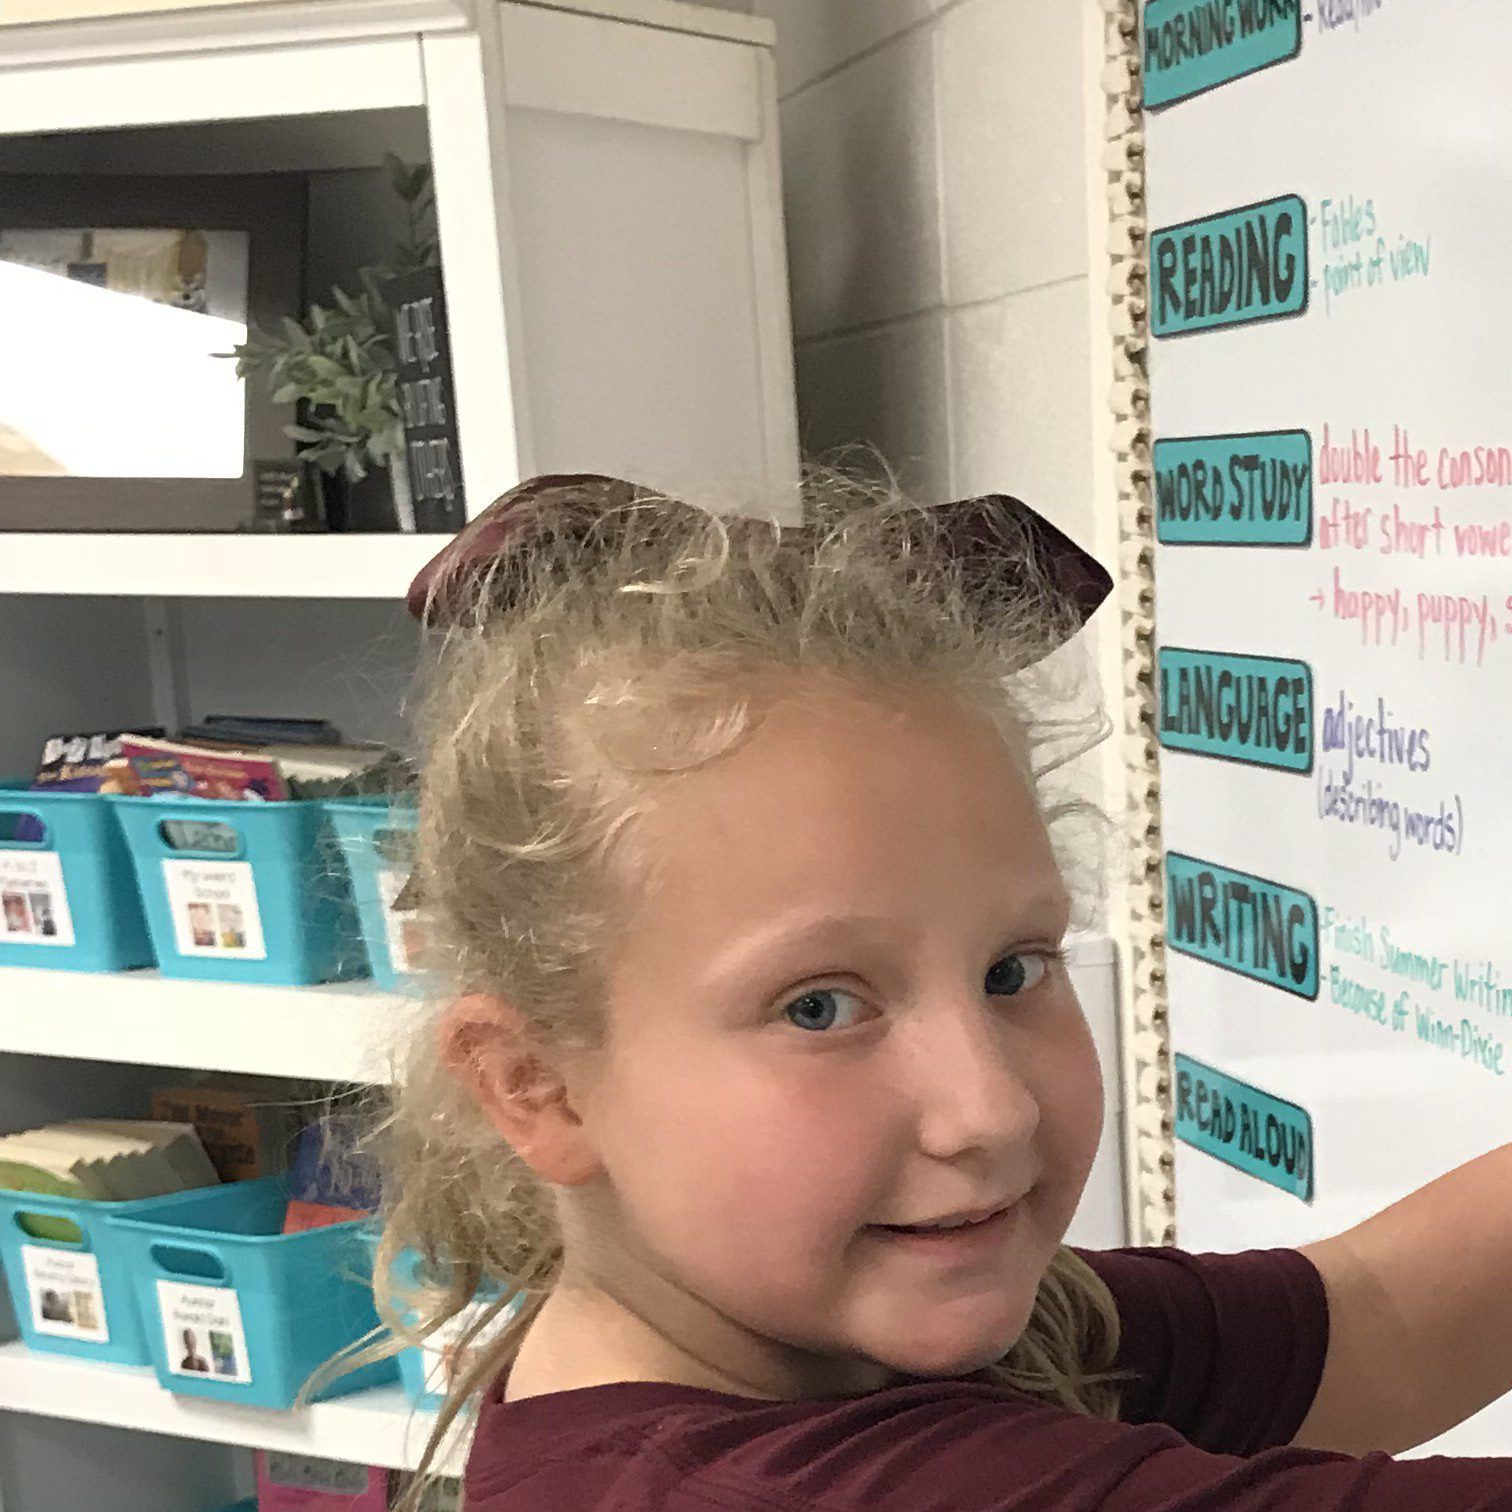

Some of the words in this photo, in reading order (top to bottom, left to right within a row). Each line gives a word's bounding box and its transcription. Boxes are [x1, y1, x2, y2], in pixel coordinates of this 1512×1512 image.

[1157, 212, 1296, 325] READING
[1156, 459, 1223, 522] WORD
[1229, 454, 1311, 522] STUDY
[1319, 422, 1383, 486] double
[1390, 424, 1430, 489] the
[1319, 498, 1373, 551] after
[1380, 503, 1445, 557] short
[1161, 664, 1308, 755] LANGUAGE
[1322, 690, 1431, 785] adjectives
[1170, 871, 1310, 985] WRITING
[1380, 928, 1449, 991] Summer
[1176, 1070, 1236, 1144] READ
